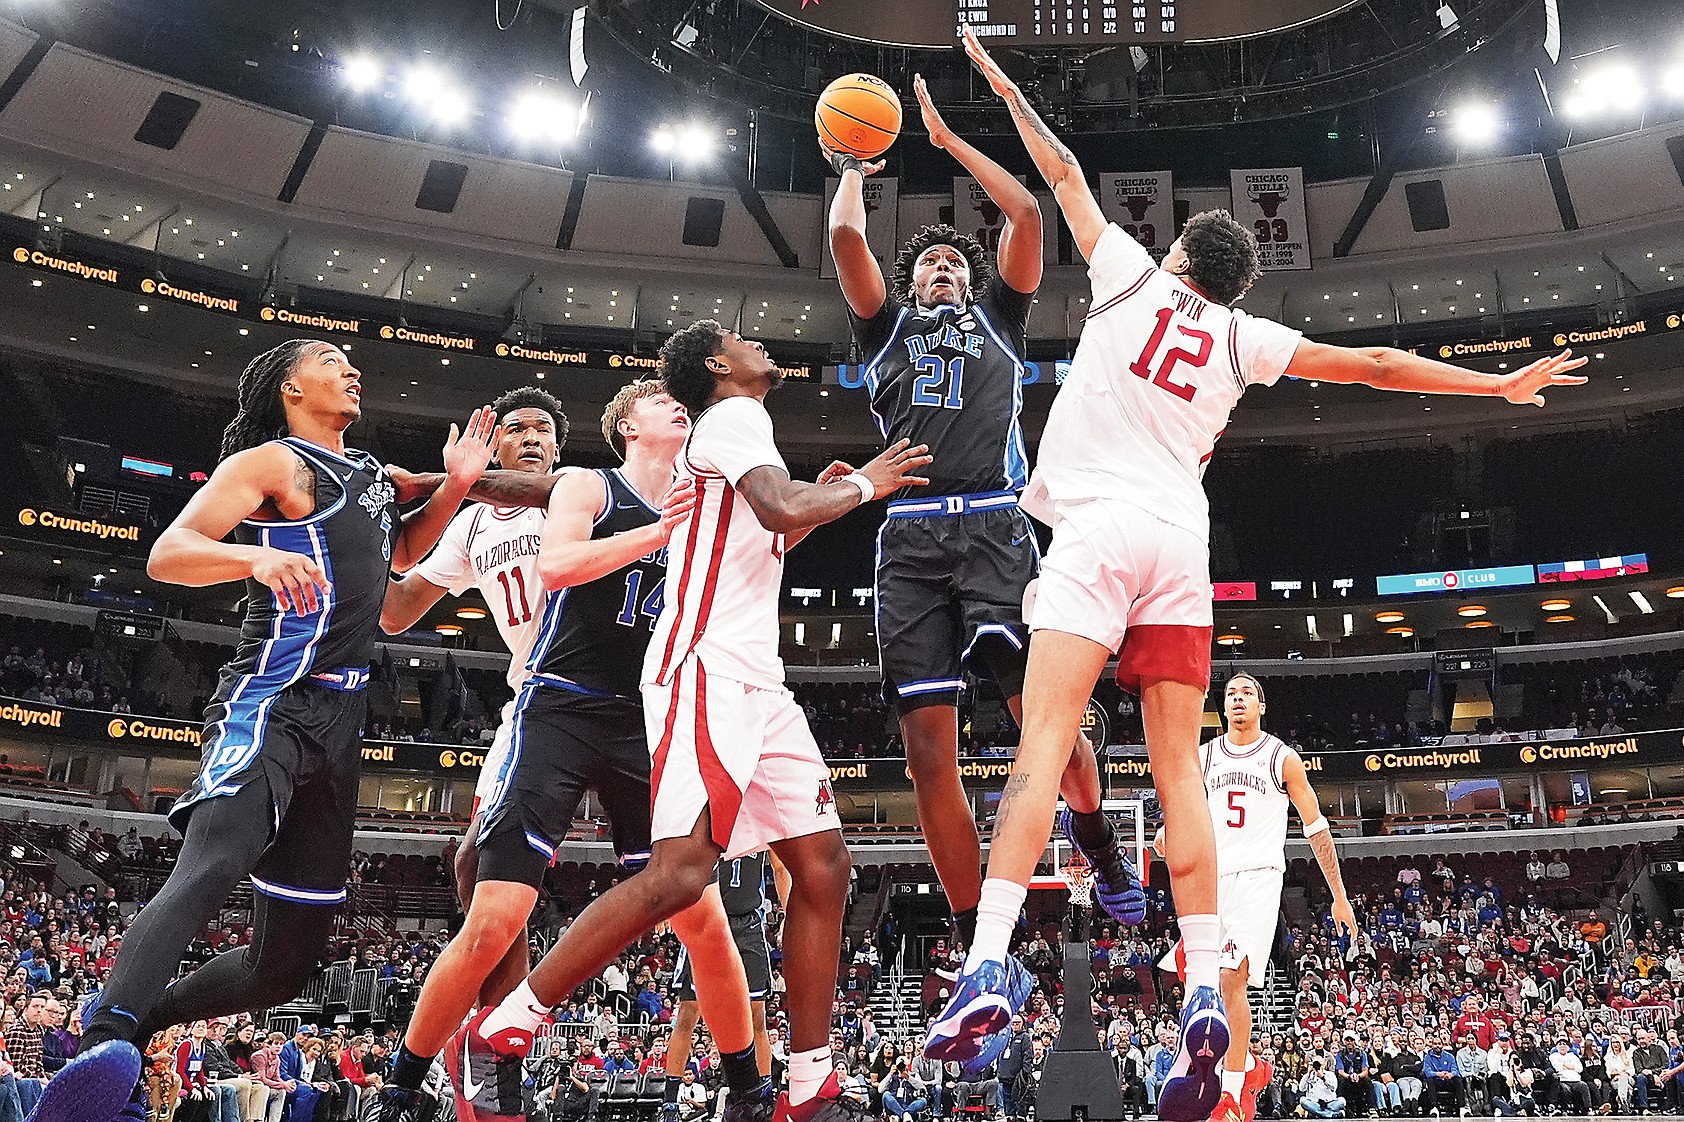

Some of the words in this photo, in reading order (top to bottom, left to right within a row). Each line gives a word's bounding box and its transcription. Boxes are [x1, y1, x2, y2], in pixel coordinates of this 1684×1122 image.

[958, 12, 966, 22] 12
[968, 11, 988, 22] EWIN
[1034, 9, 1041, 20] 3
[1050, 9, 1056, 20] 1
[1008, 24, 1016, 35] III
[1035, 23, 1041, 35] 3
[1051, 23, 1056, 35] 1
[1067, 22, 1073, 34] 5
[1114, 178, 1158, 187] CHICAGO
[1245, 175, 1289, 183] CHICAGO
[1252, 183, 1285, 192] BULLS
[1122, 187, 1153, 195] BULLS
[1254, 219, 1288, 243] 33
[32, 252, 117, 283] Crunchyroll
[158, 283, 237, 312] Crunchyroll
[278, 310, 358, 333] Crunchyroll
[1569, 321, 1646, 343] Crunchyroll
[396, 328, 473, 350] Crunchyroll
[904, 323, 985, 364] DUKE
[1454, 337, 1531, 355] Crunchyroll
[511, 345, 586, 364] Crunchyroll
[1129, 308, 1214, 403] 12
[912, 353, 965, 410] 21
[946, 496, 965, 514] D
[40, 512, 138, 541] Crunchyroll
[1415, 578, 1441, 588] BMO
[1467, 573, 1496, 584] CLUB
[497, 566, 532, 627] 11
[616, 569, 667, 632] 14
[1384, 749, 1480, 769] Crunchyroll
[1540, 739, 1639, 759] Crunchyroll
[1210, 771, 1267, 795] RAZORBACKS
[1226, 791, 1246, 828] 5
